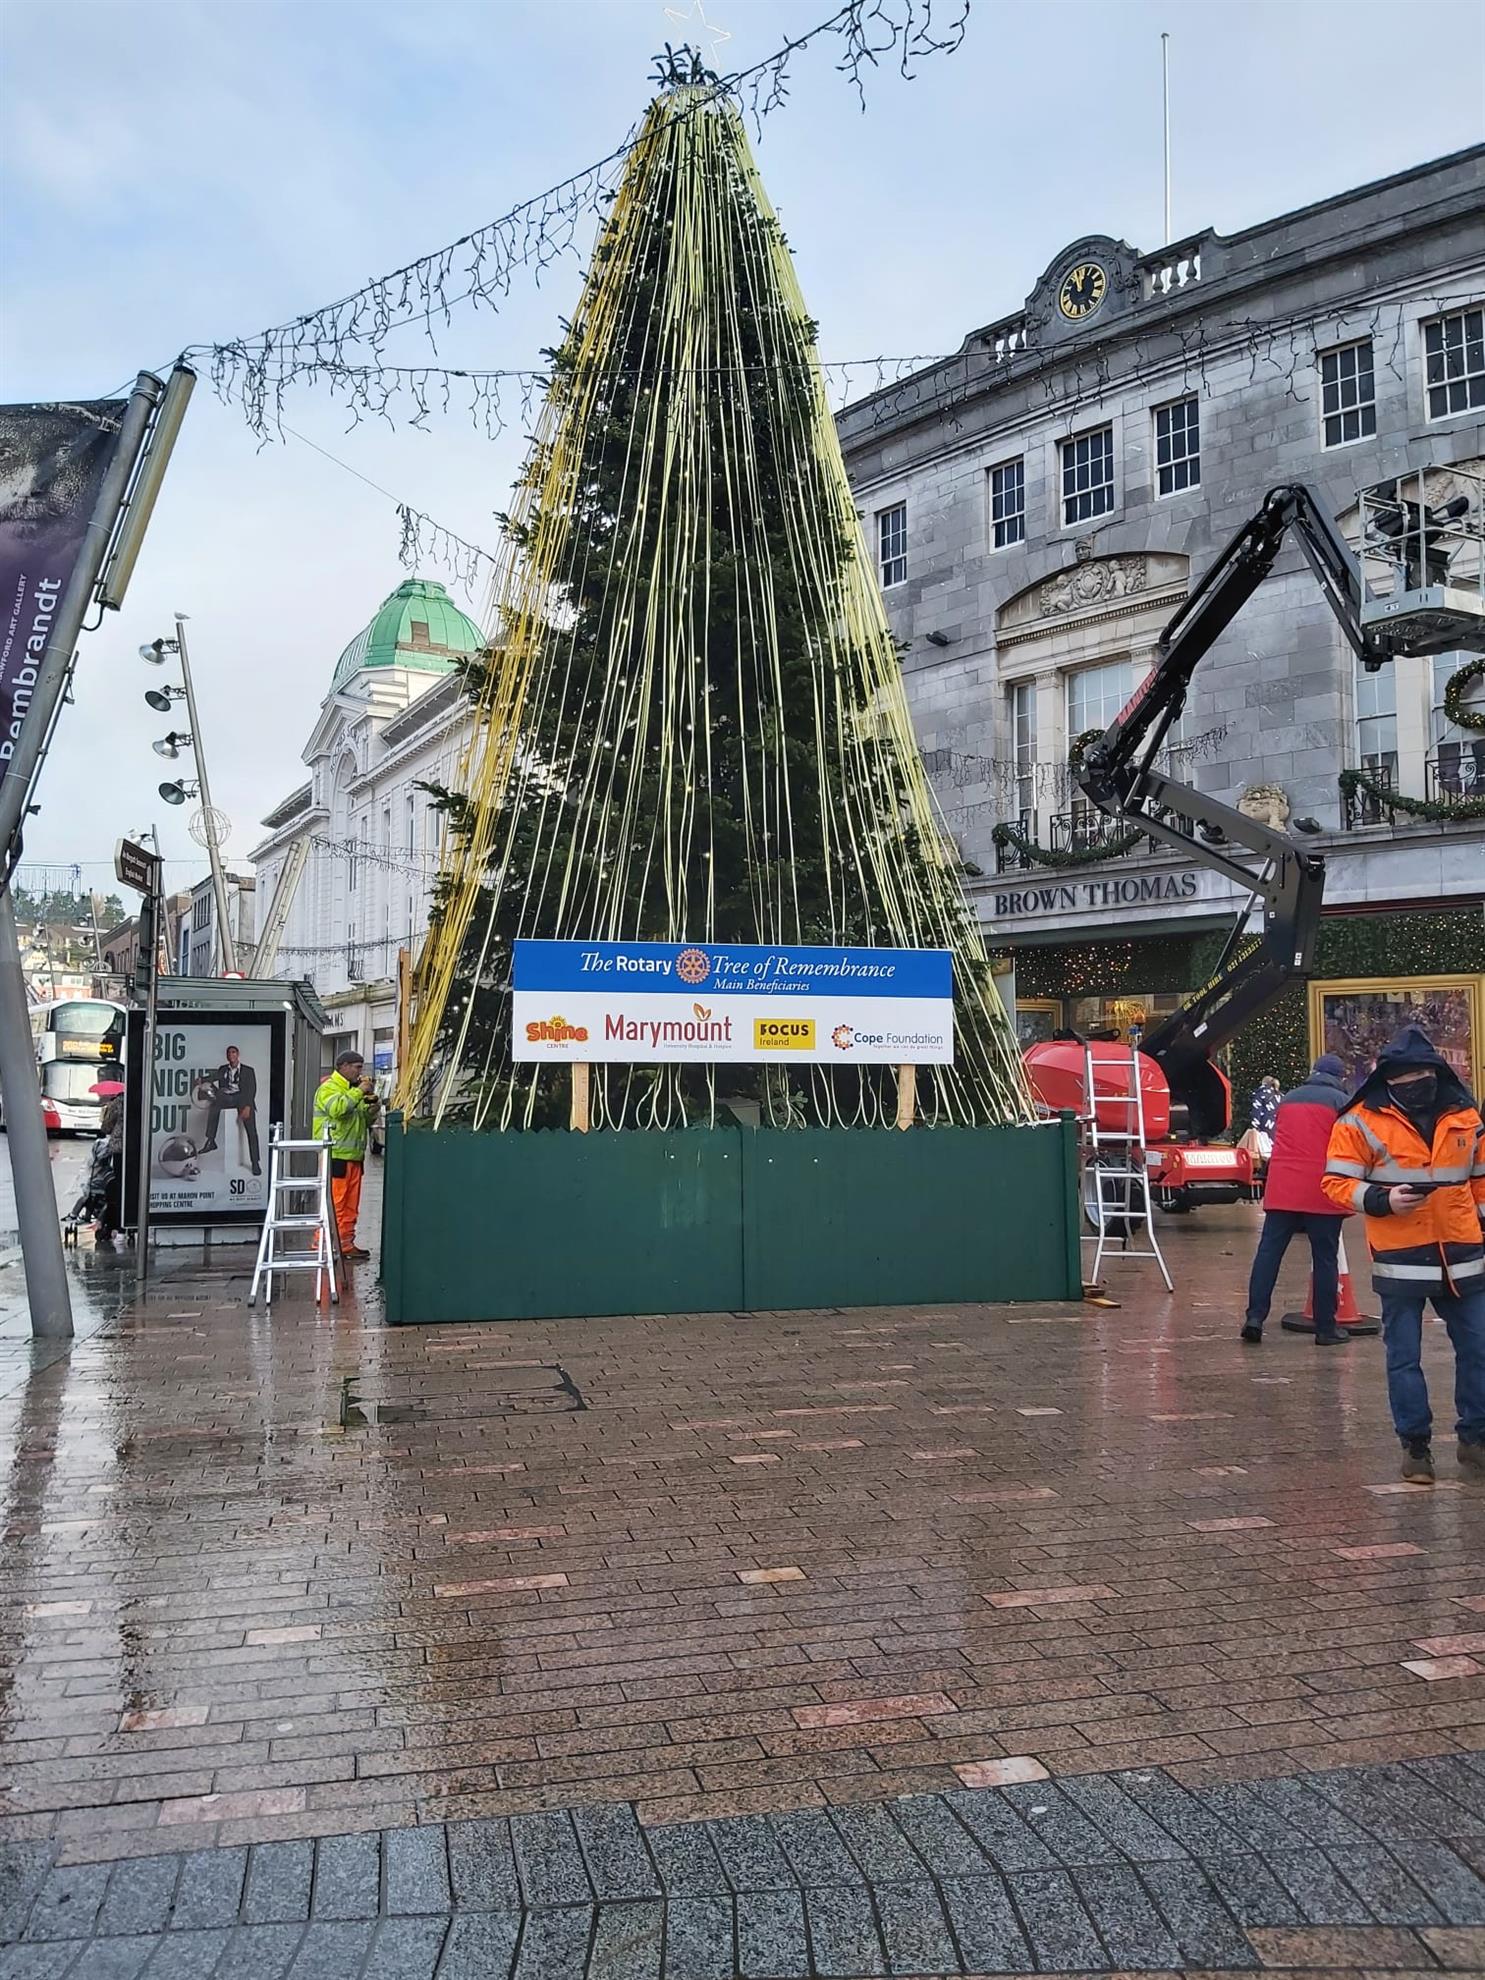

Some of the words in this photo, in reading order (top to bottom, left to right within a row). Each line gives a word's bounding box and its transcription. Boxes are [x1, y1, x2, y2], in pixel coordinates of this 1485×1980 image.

[13, 573, 27, 616] GALLERY
[9, 617, 18, 638] ART
[0, 638, 13, 685] AWFORD
[994, 886, 1076, 916] BROWN
[1083, 873, 1197, 906] THOMAS
[580, 952, 613, 972] The
[616, 956, 672, 976] Rotary
[712, 955, 750, 975] Tree
[754, 955, 776, 981] of
[774, 957, 896, 978] Remembrance
[713, 979, 743, 991] Main
[746, 979, 810, 994] Beneficiaries
[526, 1020, 589, 1042] Shine
[605, 1014, 733, 1048] Marymount
[759, 1037, 790, 1046] Ireland
[760, 1023, 809, 1036] FOCUS
[854, 1032, 883, 1045] Cope
[886, 1032, 943, 1044] Foundation
[152, 1033, 186, 1061] BIG
[151, 1104, 191, 1133] OUT
[150, 1192, 160, 1200] ISIT
